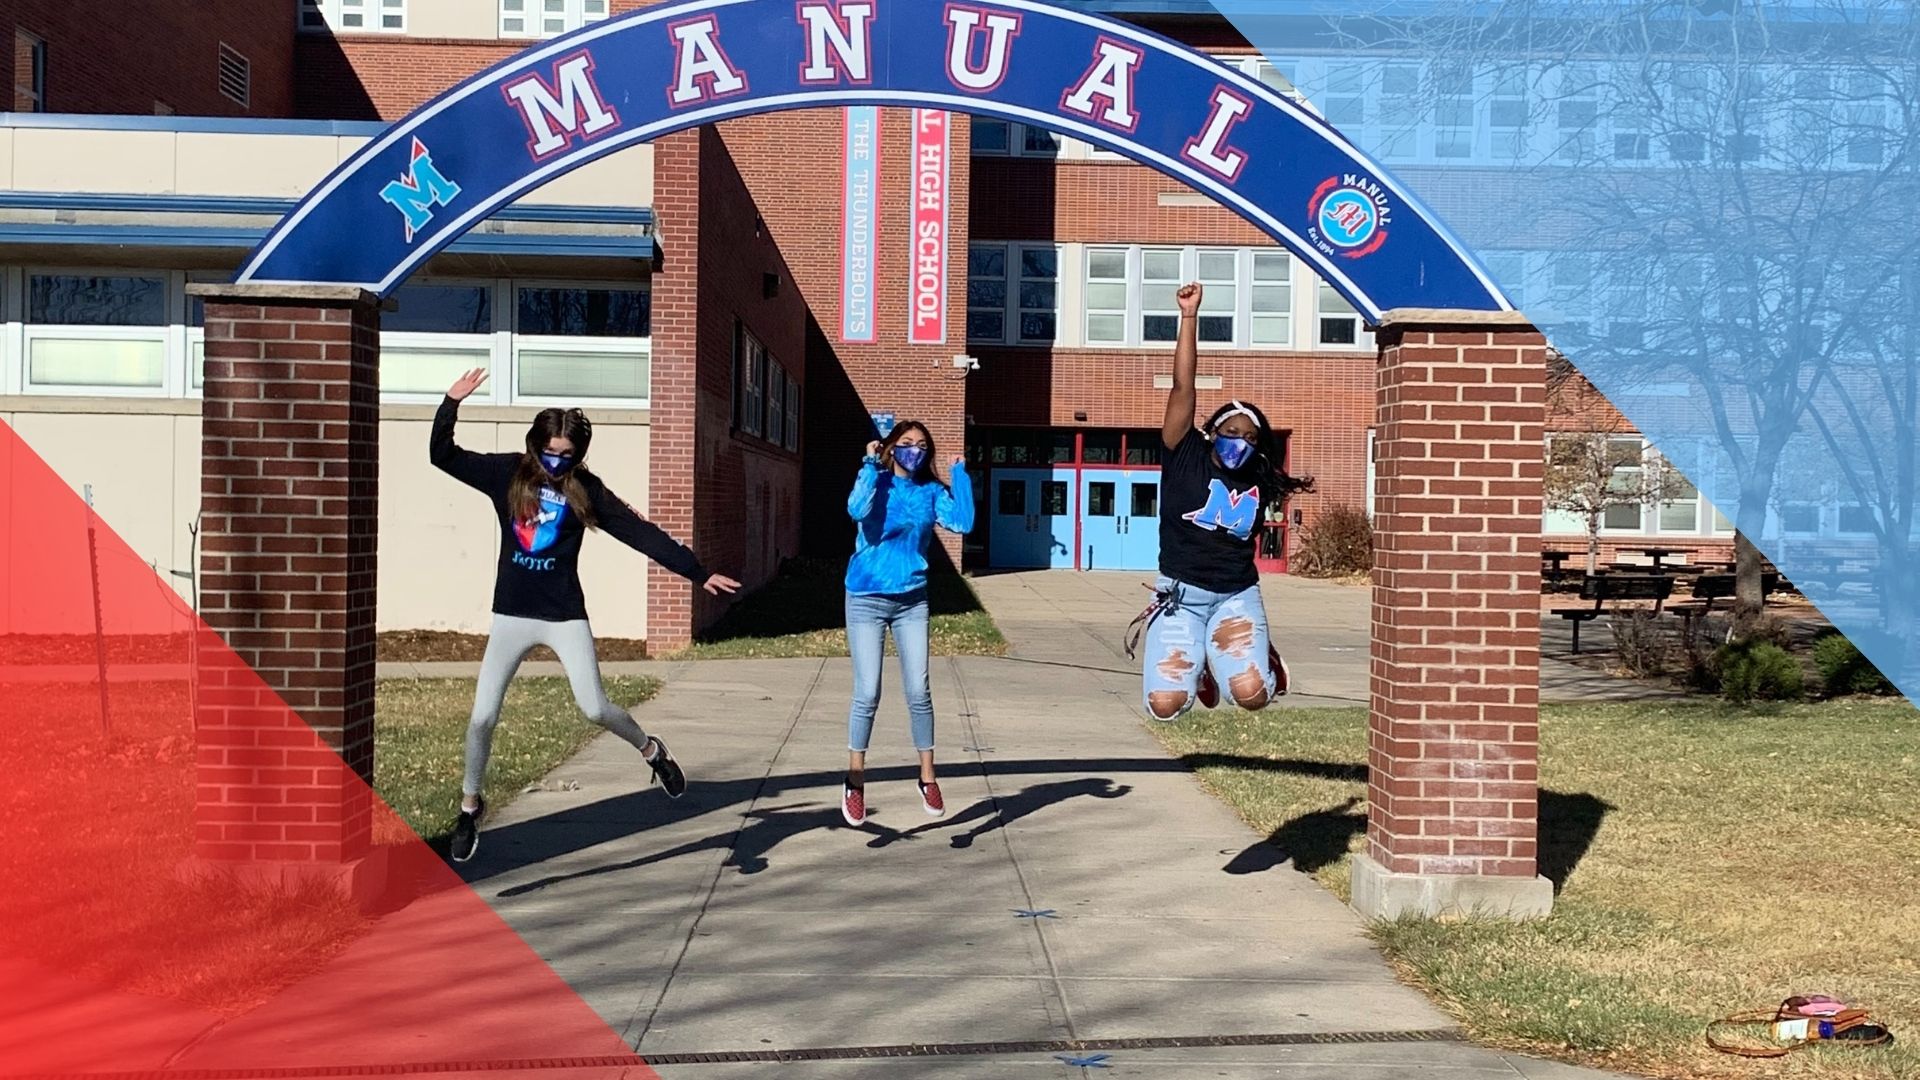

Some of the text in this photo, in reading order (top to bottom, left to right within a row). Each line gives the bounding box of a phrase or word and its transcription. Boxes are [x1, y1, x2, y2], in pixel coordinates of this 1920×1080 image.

[503, 0, 1254, 184] MANUAL
[919, 143, 941, 211] HIGH
[1343, 173, 1392, 226] MANUAL
[850, 120, 870, 333] THE THUNDERBOLTS
[917, 220, 940, 327] SCHOOL
[1182, 478, 1260, 541] M
